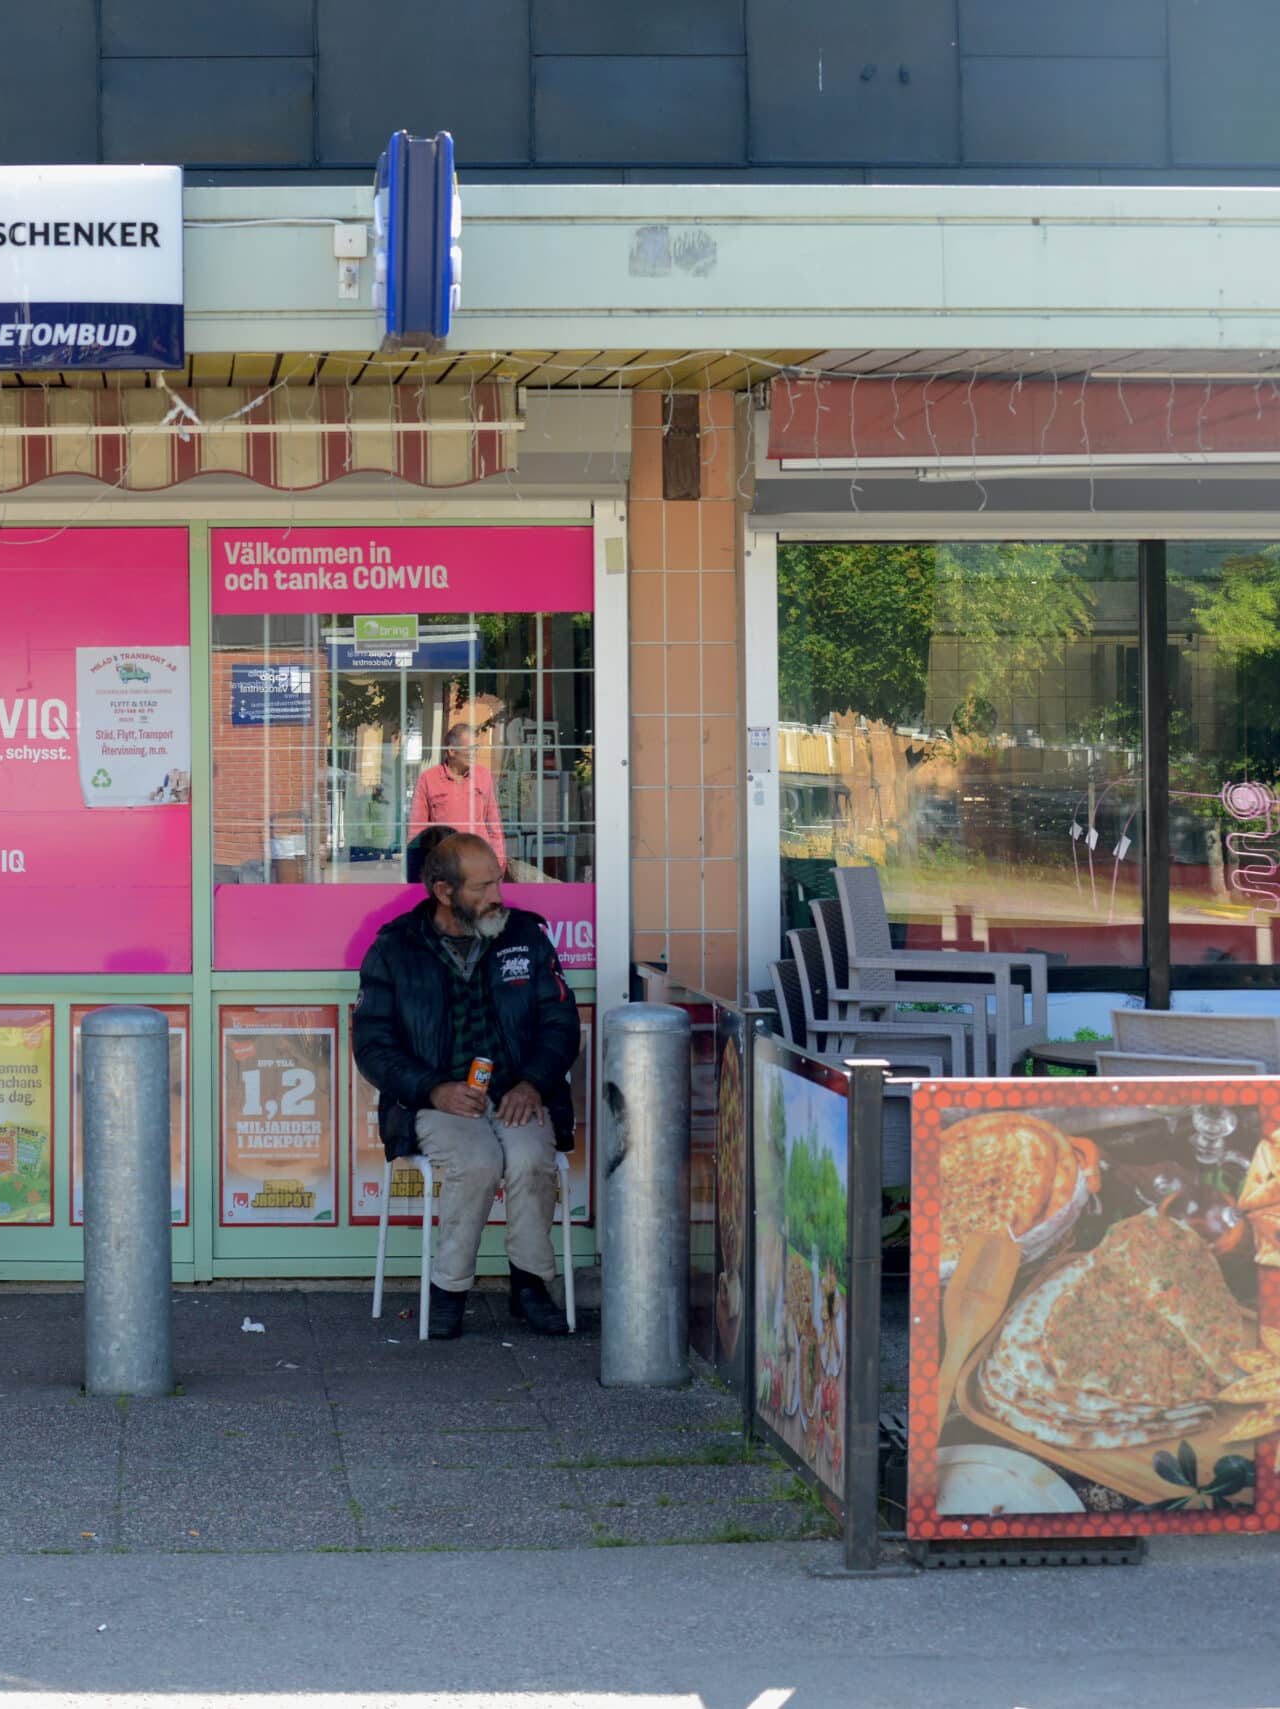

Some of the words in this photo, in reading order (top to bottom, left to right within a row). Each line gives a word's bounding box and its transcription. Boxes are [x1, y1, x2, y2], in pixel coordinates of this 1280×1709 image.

[224, 541, 363, 565] Välkommen
[369, 541, 391, 564] in
[224, 567, 268, 591] och
[274, 567, 348, 591] tanka
[353, 565, 449, 590] COMVIQ
[138, 729, 173, 741] Transport
[6, 745, 71, 763] schysst.
[548, 921, 595, 948] VIQ
[558, 951, 595, 964] chysst.
[241, 1068, 316, 1119] 1,2
[236, 1121, 322, 1134] MILJARDER
[248, 1135, 320, 1148] JACKPOT!
